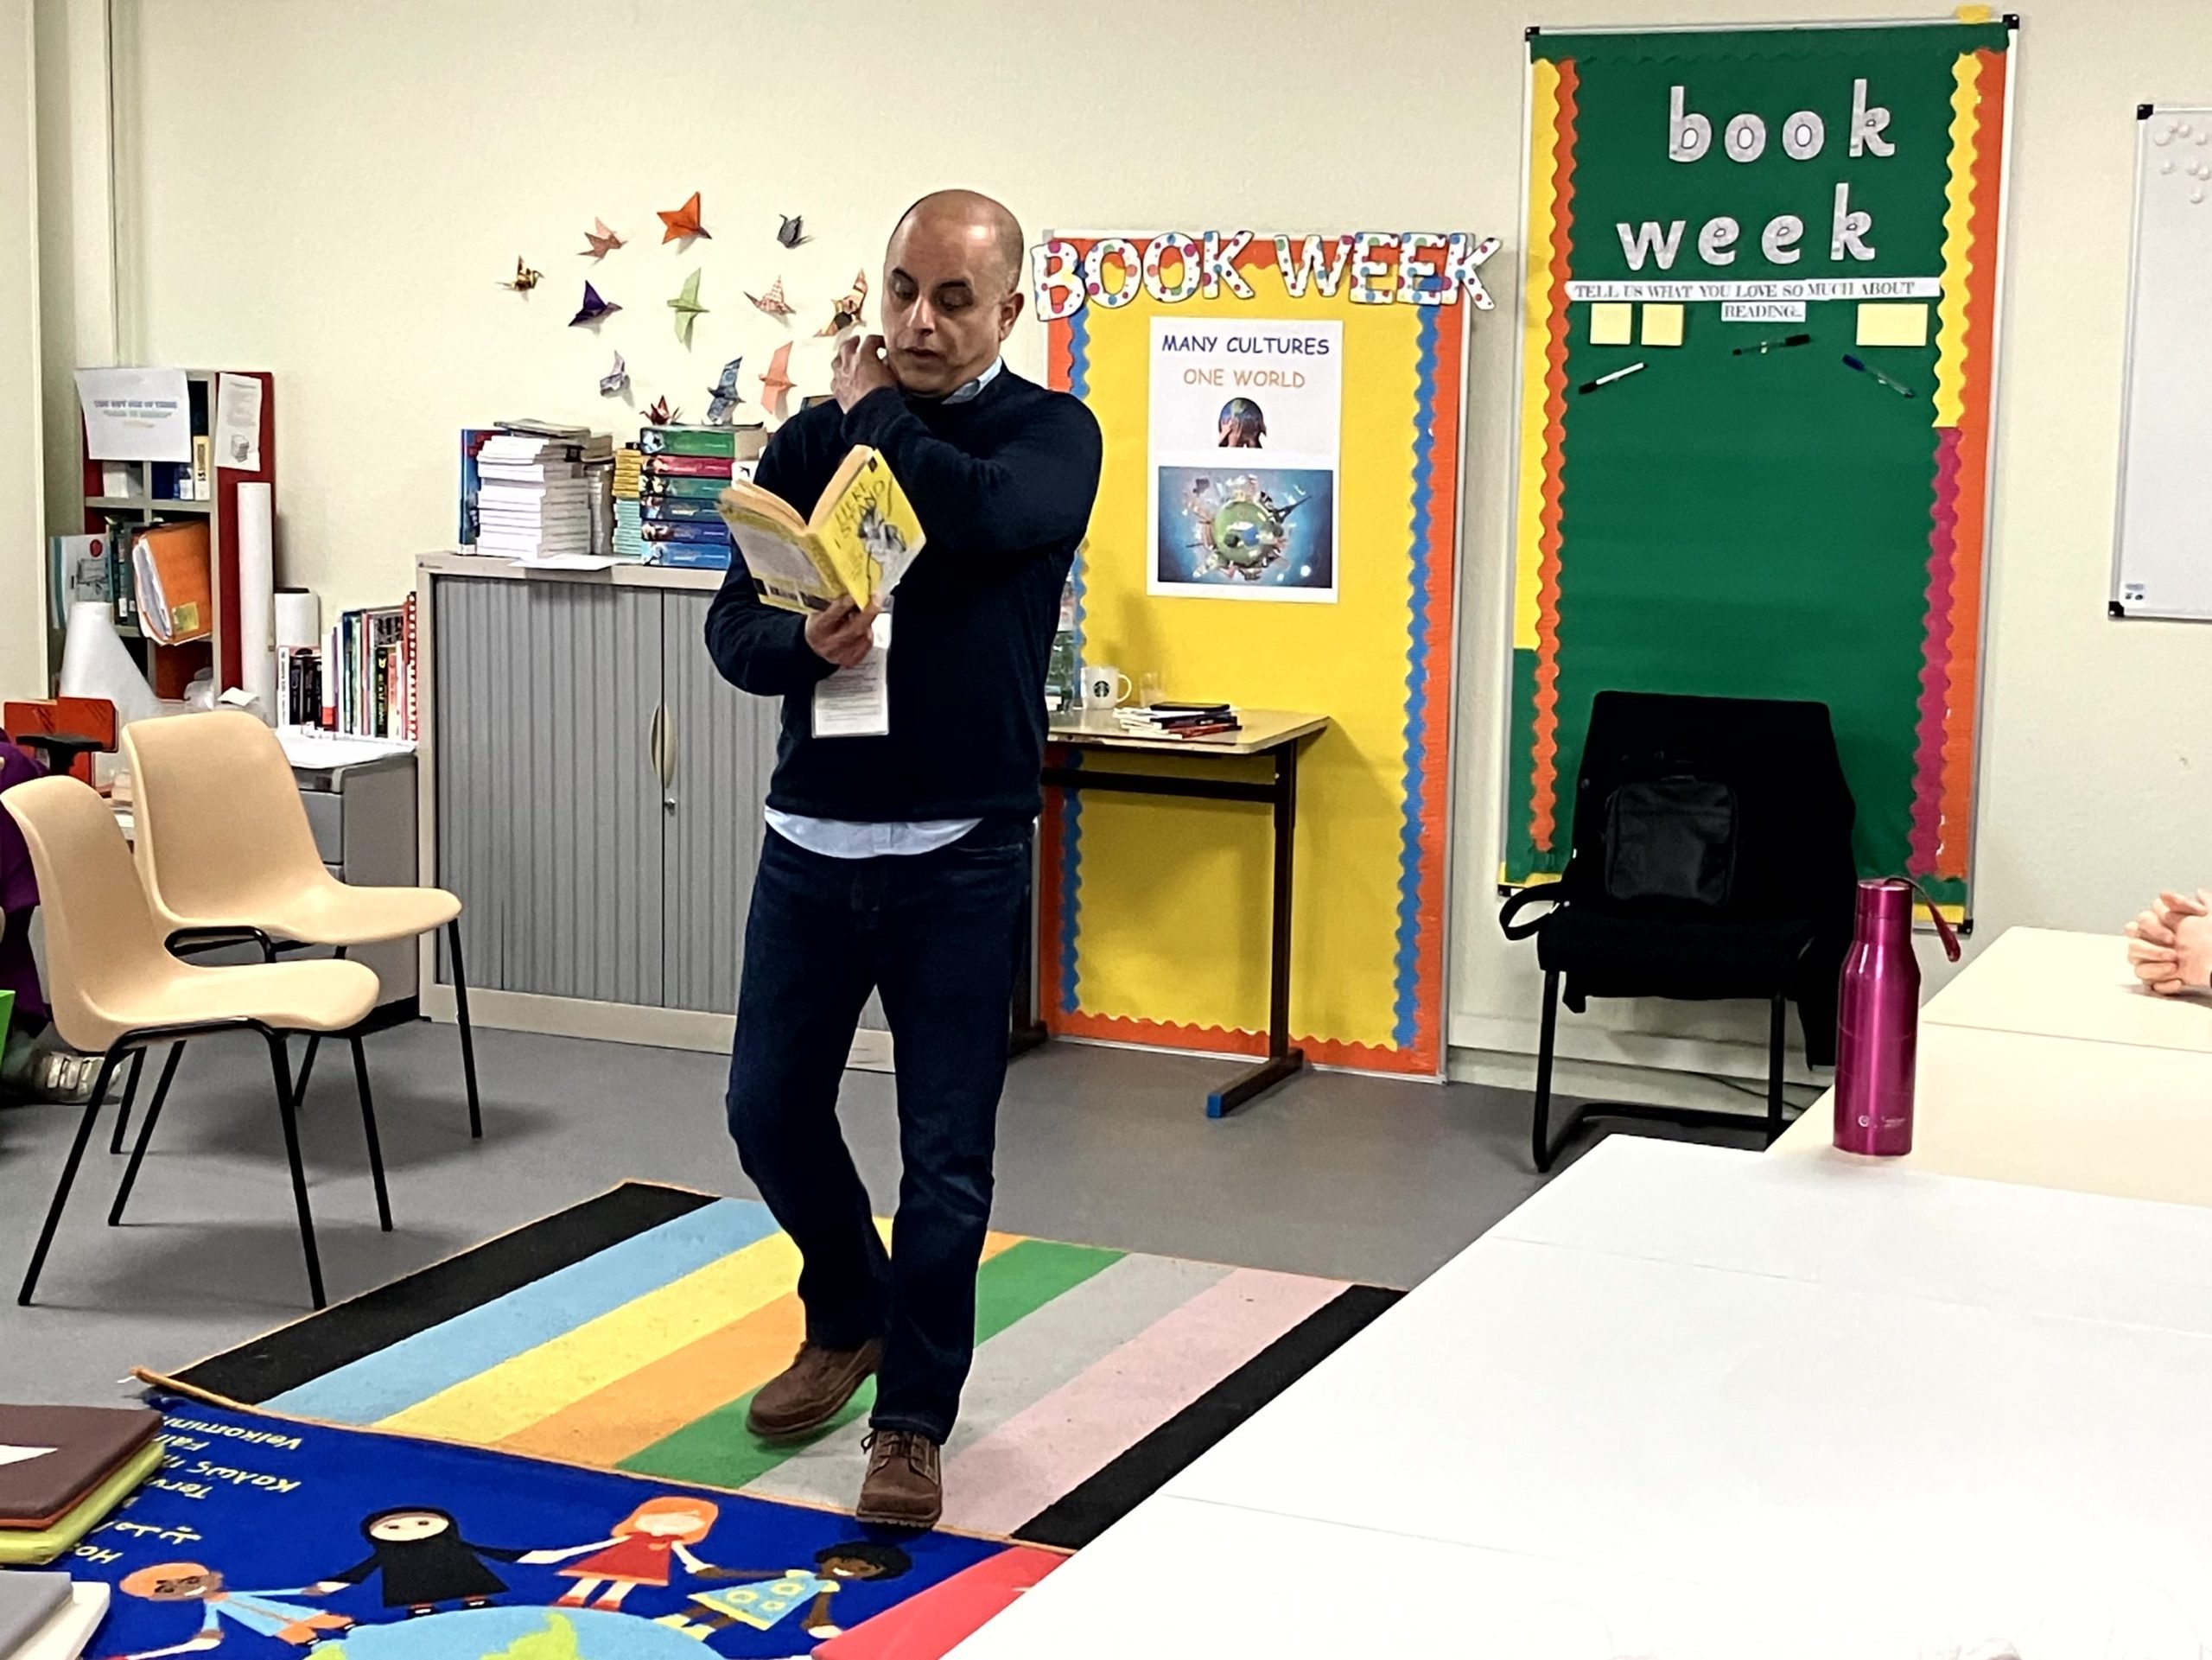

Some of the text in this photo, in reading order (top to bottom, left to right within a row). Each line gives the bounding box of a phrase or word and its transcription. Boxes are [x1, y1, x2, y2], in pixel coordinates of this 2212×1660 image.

[1669, 78, 1895, 162] book
[1616, 182, 1875, 270] week
[1030, 230, 1502, 321] BOOK WEEK
[1575, 281, 1915, 298] TELL US WHAT YOU LOVE SO MUCH ABOUT
[1161, 334, 1331, 356] MANY CULTURES
[1183, 368, 1306, 389] ONE WORLD
[69, 1542, 124, 1564] Ho
